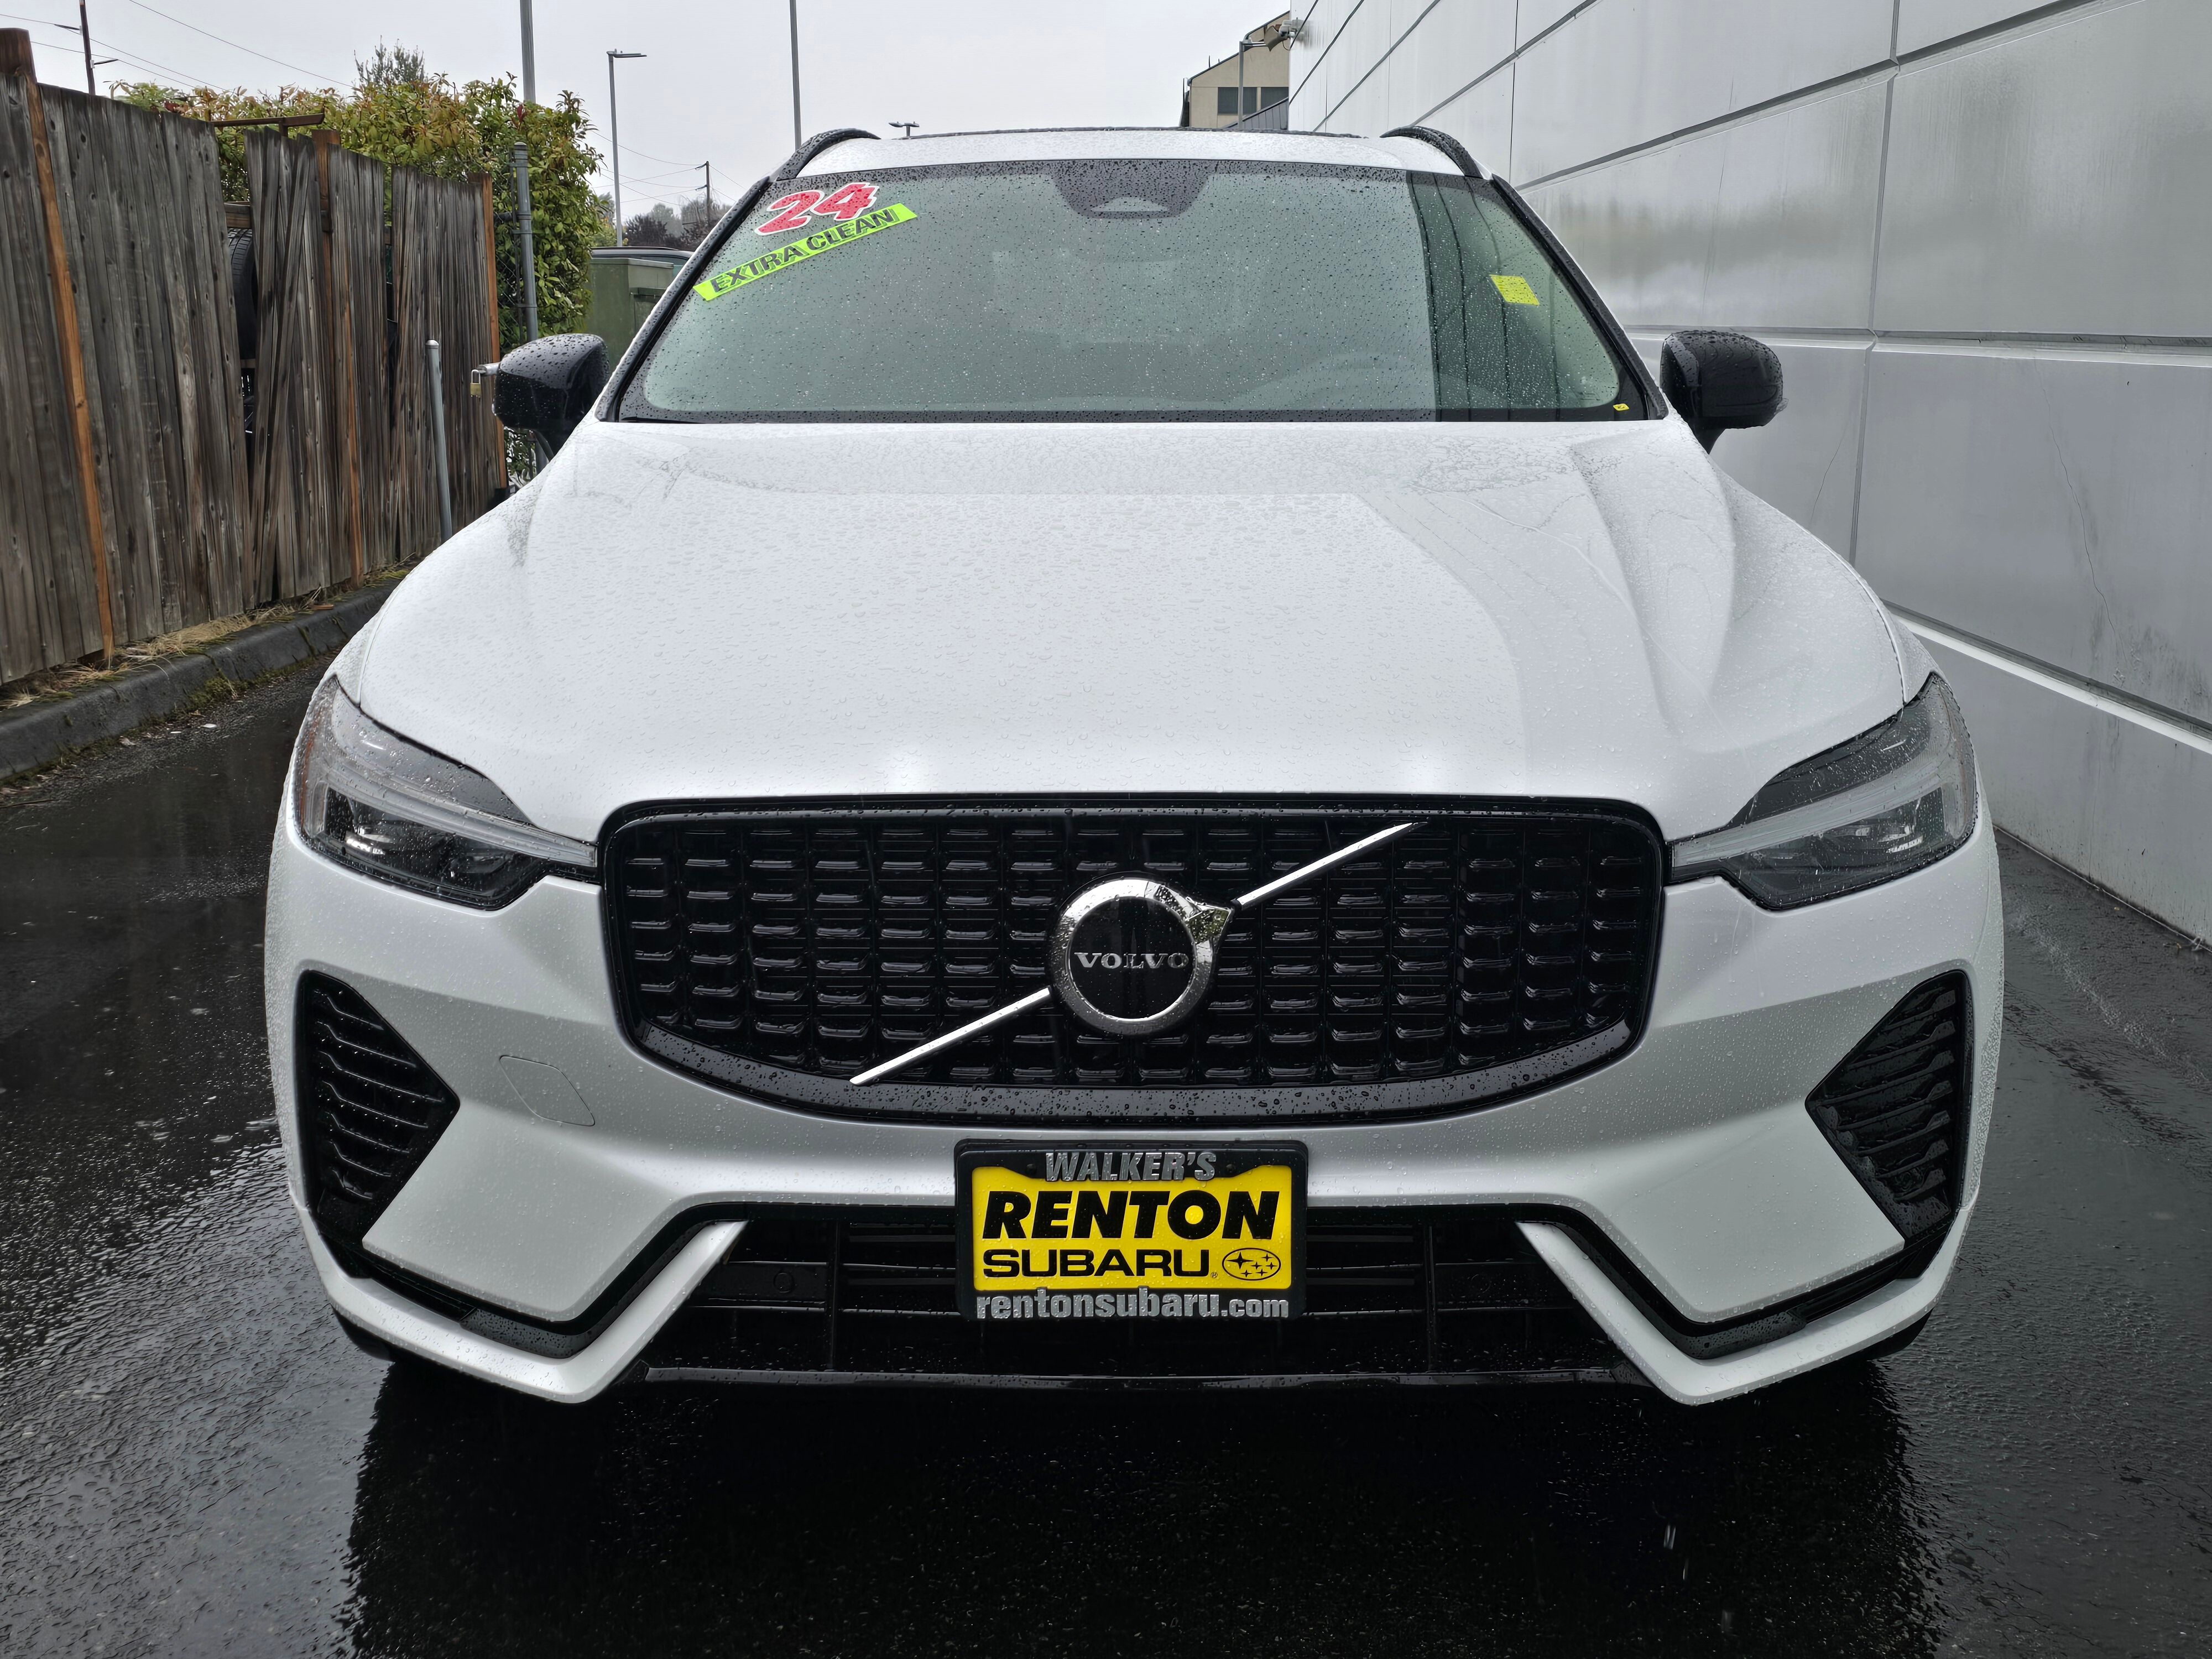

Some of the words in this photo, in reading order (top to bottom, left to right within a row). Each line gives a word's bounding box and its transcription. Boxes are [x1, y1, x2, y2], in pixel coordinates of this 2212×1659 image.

[754, 182, 879, 236] 24
[711, 244, 805, 293] EXTRA
[806, 209, 896, 251] CLEAN
[1074, 952, 1189, 968] VOLVO
[1045, 1151, 1217, 1181] WALKER'S
[982, 1190, 1280, 1240] RENTON
[983, 1249, 1210, 1277] SUBARU
[976, 1286, 1289, 1319] rentonsubaru.com
